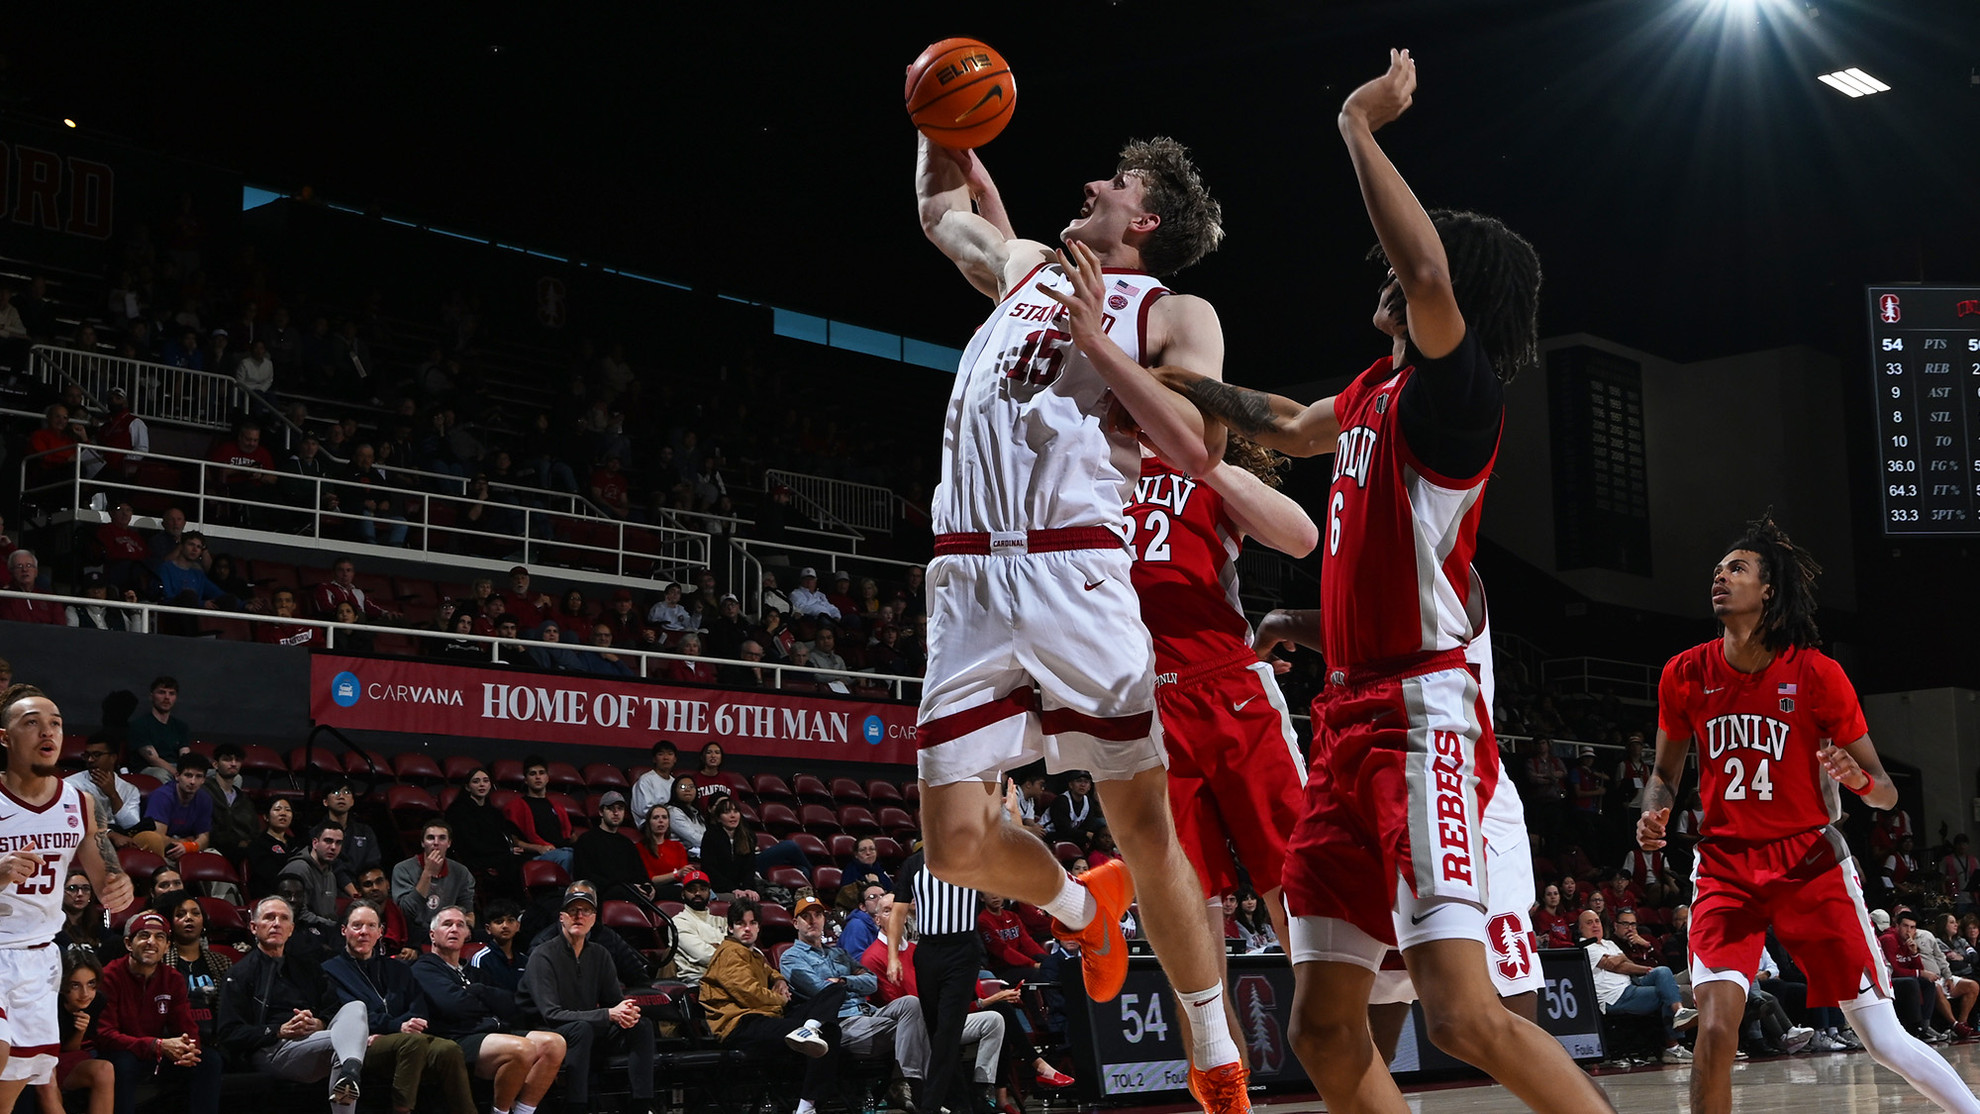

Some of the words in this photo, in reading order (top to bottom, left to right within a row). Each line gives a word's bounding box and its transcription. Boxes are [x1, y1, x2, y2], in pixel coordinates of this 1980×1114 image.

[936, 53, 993, 86] ELITE
[1009, 302, 1116, 335] STANFD
[1882, 338, 1904, 351] 54
[1924, 338, 1948, 349] PTS
[1968, 338, 1980, 351] 5
[1006, 328, 1072, 386] 15
[1885, 362, 1903, 375] 33
[1924, 363, 1950, 374] REB
[1891, 386, 1901, 399] 9
[1927, 387, 1952, 398] AST
[1893, 410, 1903, 423] 8
[1929, 411, 1952, 422] STL
[1891, 435, 1908, 447] 10
[1935, 436, 1952, 447] TO
[1332, 426, 1377, 488] NLV
[1887, 460, 1915, 472] 36.0
[1122, 473, 1197, 516] NLV
[1889, 484, 1917, 497] 64.3
[1330, 491, 1344, 556] 6
[1890, 509, 1919, 522] 33.3
[993, 539, 1024, 547] CARDINAL
[367, 682, 464, 706] CARVANA
[481, 682, 588, 725] HOME
[593, 692, 640, 728] OF
[643, 697, 709, 734] THE
[714, 703, 776, 737] 6TH
[781, 707, 850, 744] MAN
[888, 724, 917, 740] CAR
[1705, 713, 1790, 762] UNLV
[1723, 757, 1773, 801] 24
[1431, 729, 1473, 887] REBELS
[0, 833, 80, 853] STANFORD
[16, 854, 62, 895] 25
[1544, 978, 1578, 1020] 56
[1121, 992, 1168, 1044] 54
[1574, 1044, 1594, 1056] Fouls
[1112, 1074, 1136, 1088] TOL
[1137, 1073, 1145, 1086] 2
